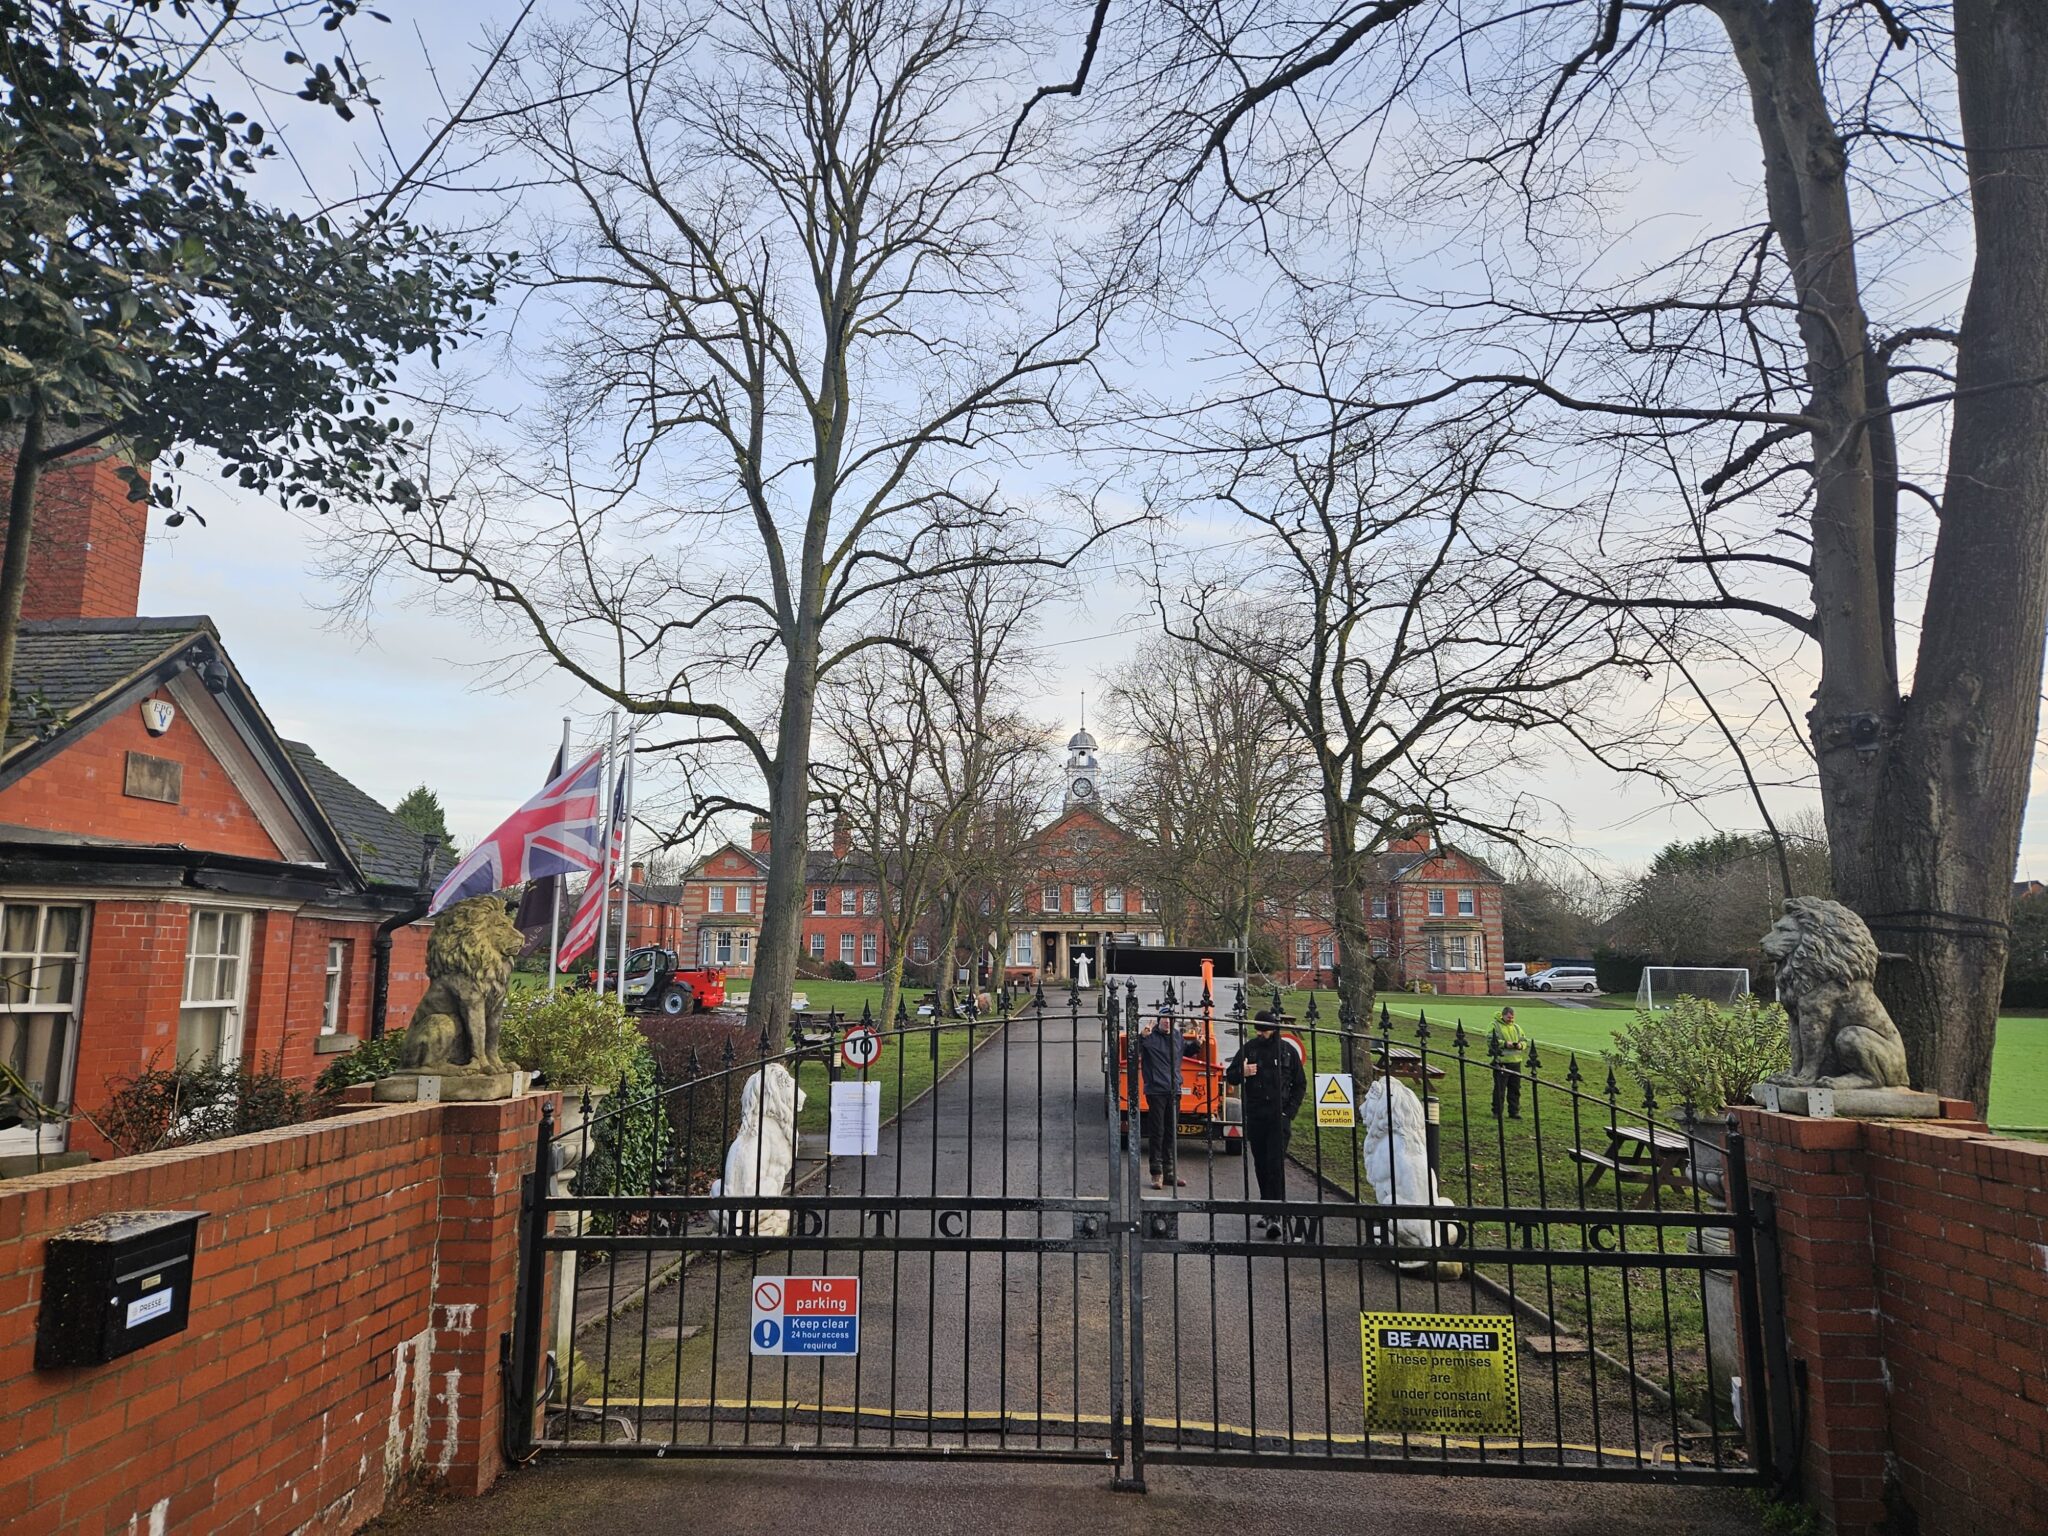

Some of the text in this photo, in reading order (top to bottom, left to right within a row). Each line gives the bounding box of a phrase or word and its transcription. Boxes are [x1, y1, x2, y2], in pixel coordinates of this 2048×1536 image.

[851, 1039, 873, 1056] 10
[812, 1280, 832, 1292] No
[796, 1297, 847, 1312] parking
[792, 1318, 849, 1330] Keep clear
[791, 1331, 849, 1339] 24 hour access
[1387, 1331, 1490, 1349] BE AWARE!
[803, 1341, 837, 1350] required
[1388, 1353, 1491, 1368] These premises
[1430, 1374, 1450, 1383] are
[1391, 1388, 1491, 1401] under constant
[1402, 1406, 1482, 1418] surveillance
